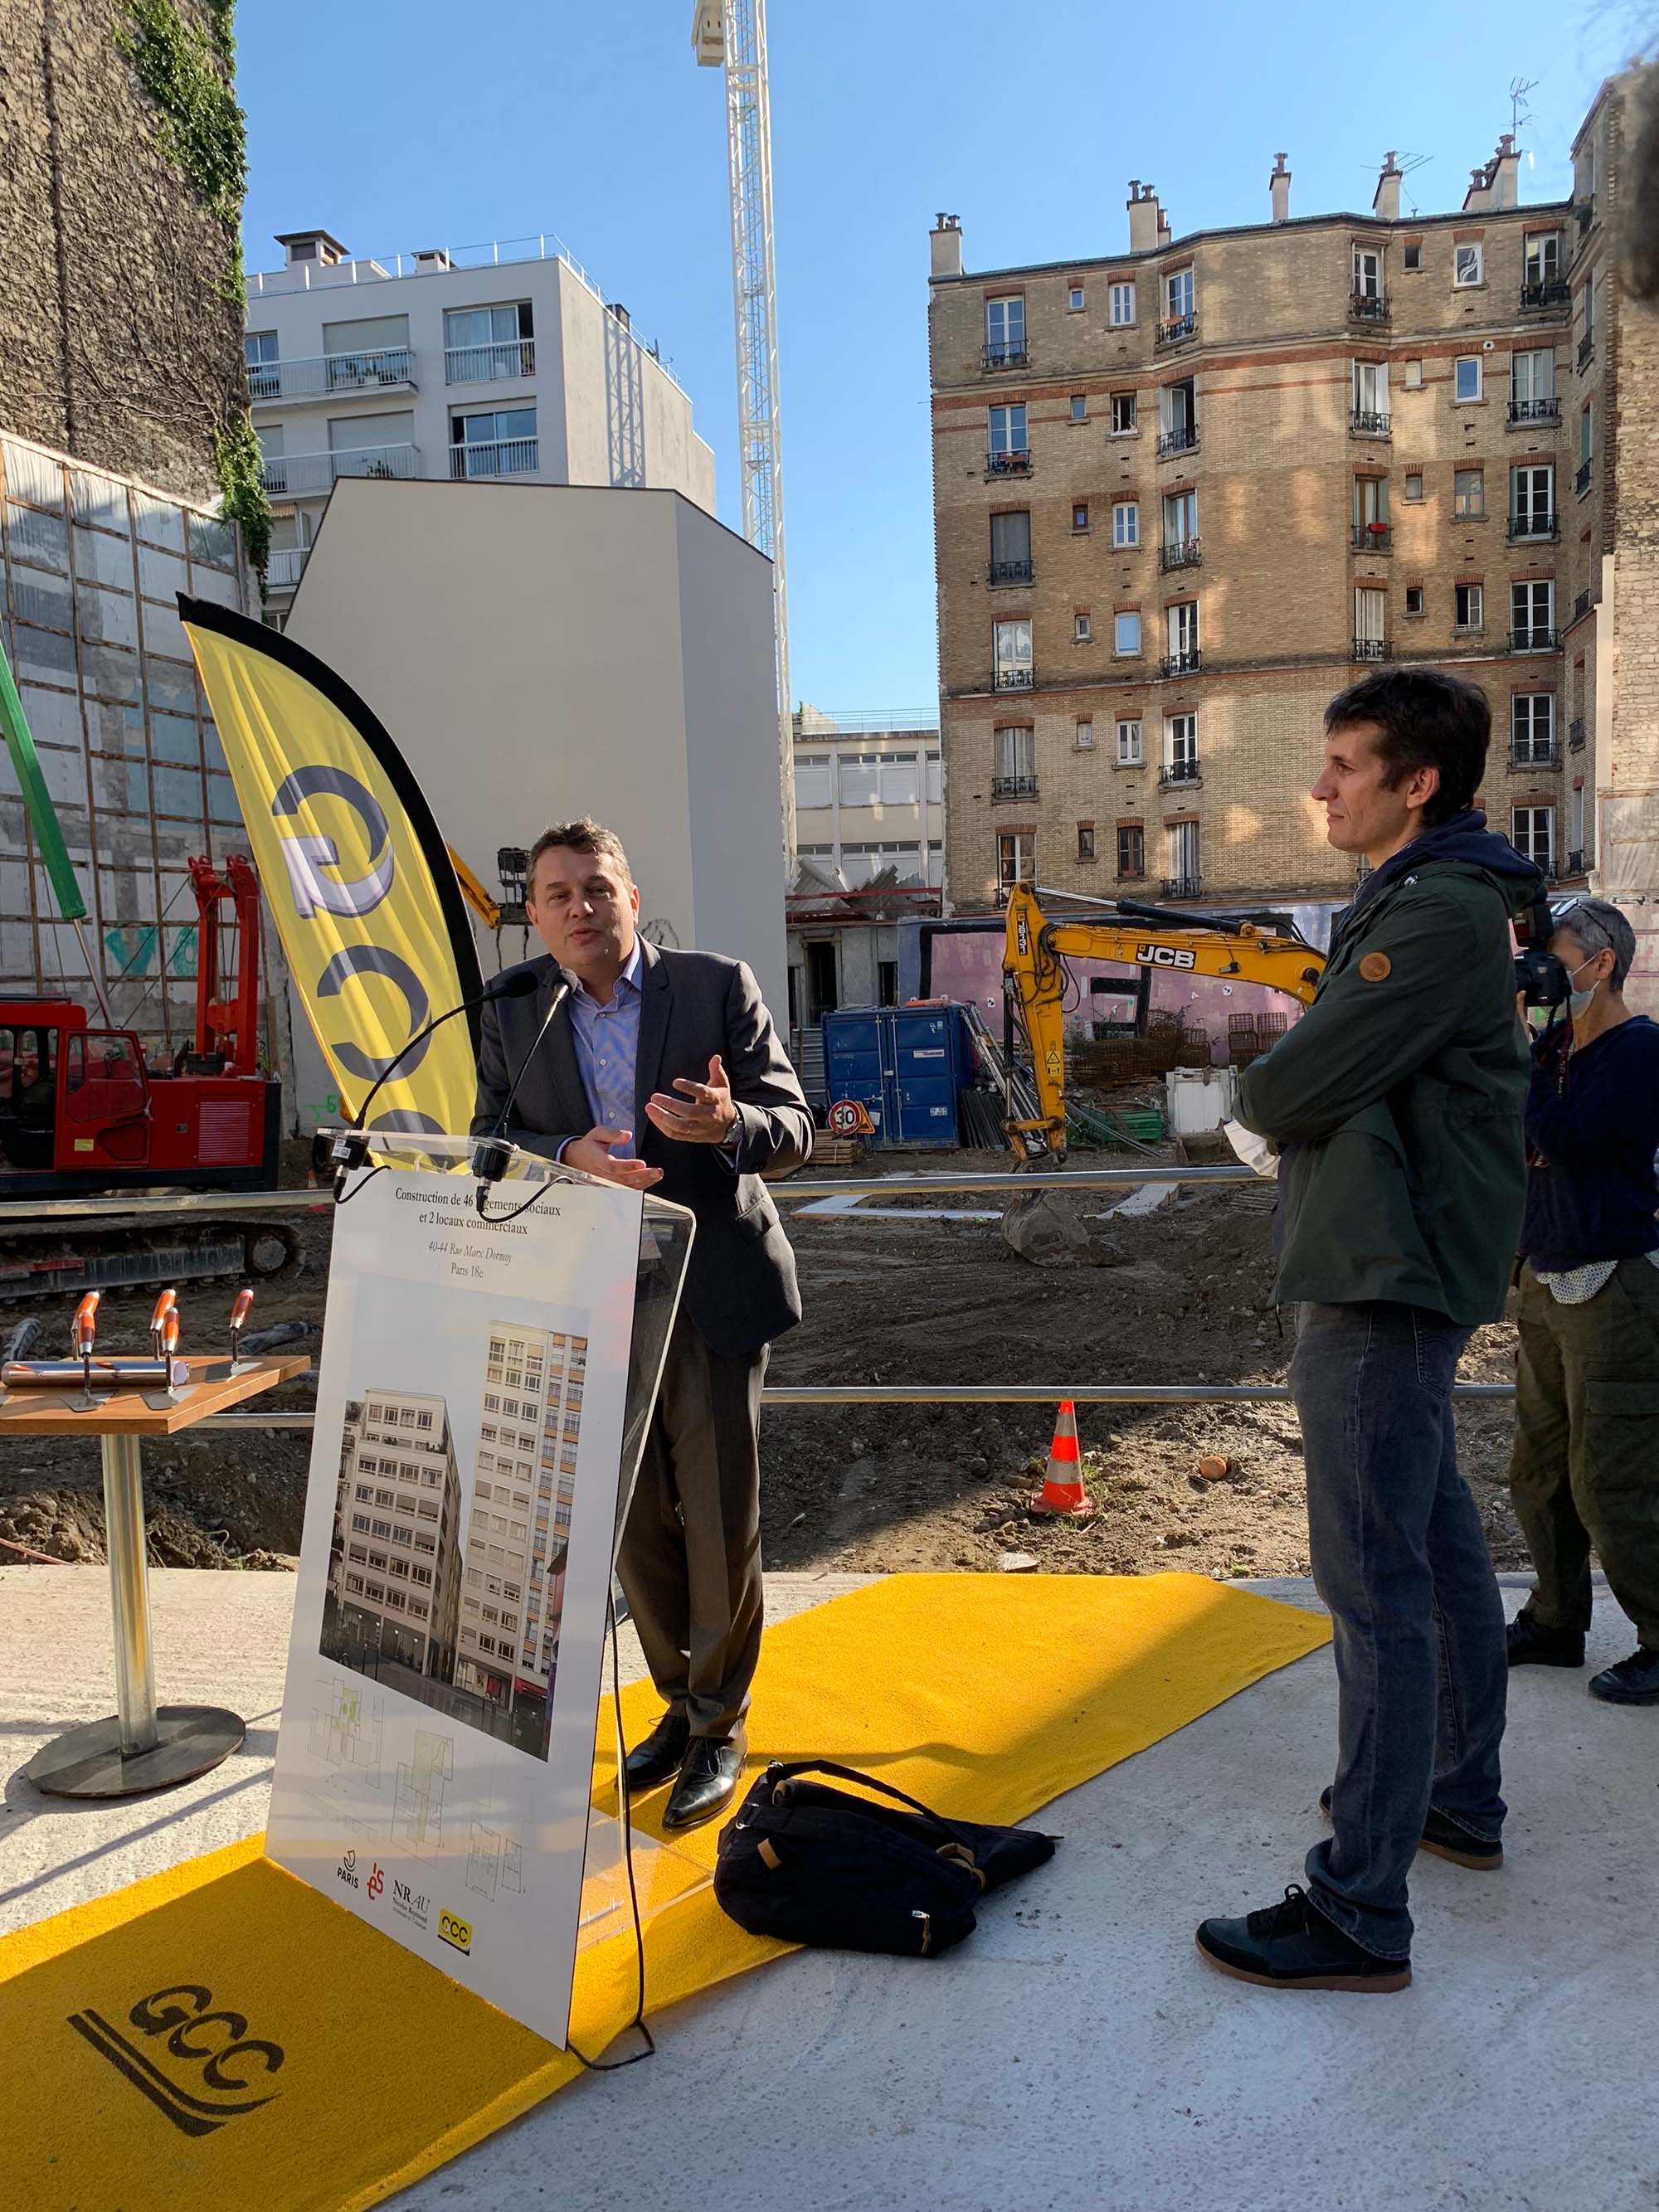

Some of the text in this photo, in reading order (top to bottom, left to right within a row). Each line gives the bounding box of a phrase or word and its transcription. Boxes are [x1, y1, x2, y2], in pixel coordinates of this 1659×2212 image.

[1137, 946, 1194, 969] JCB
[835, 1110, 855, 1125] 30
[395, 1187, 449, 1204] Construction
[450, 1193, 461, 1206] de
[463, 1194, 474, 1207] 46
[484, 1199, 523, 1213] gements
[419, 1212, 528, 1235] et 2 locaux commerciaux
[428, 1241, 512, 1266] 40-44 Rue Marx Dormoy
[450, 1262, 484, 1278] Paris 18e
[337, 1867, 359, 1889] PARIS
[129, 1984, 285, 2091] GCC
